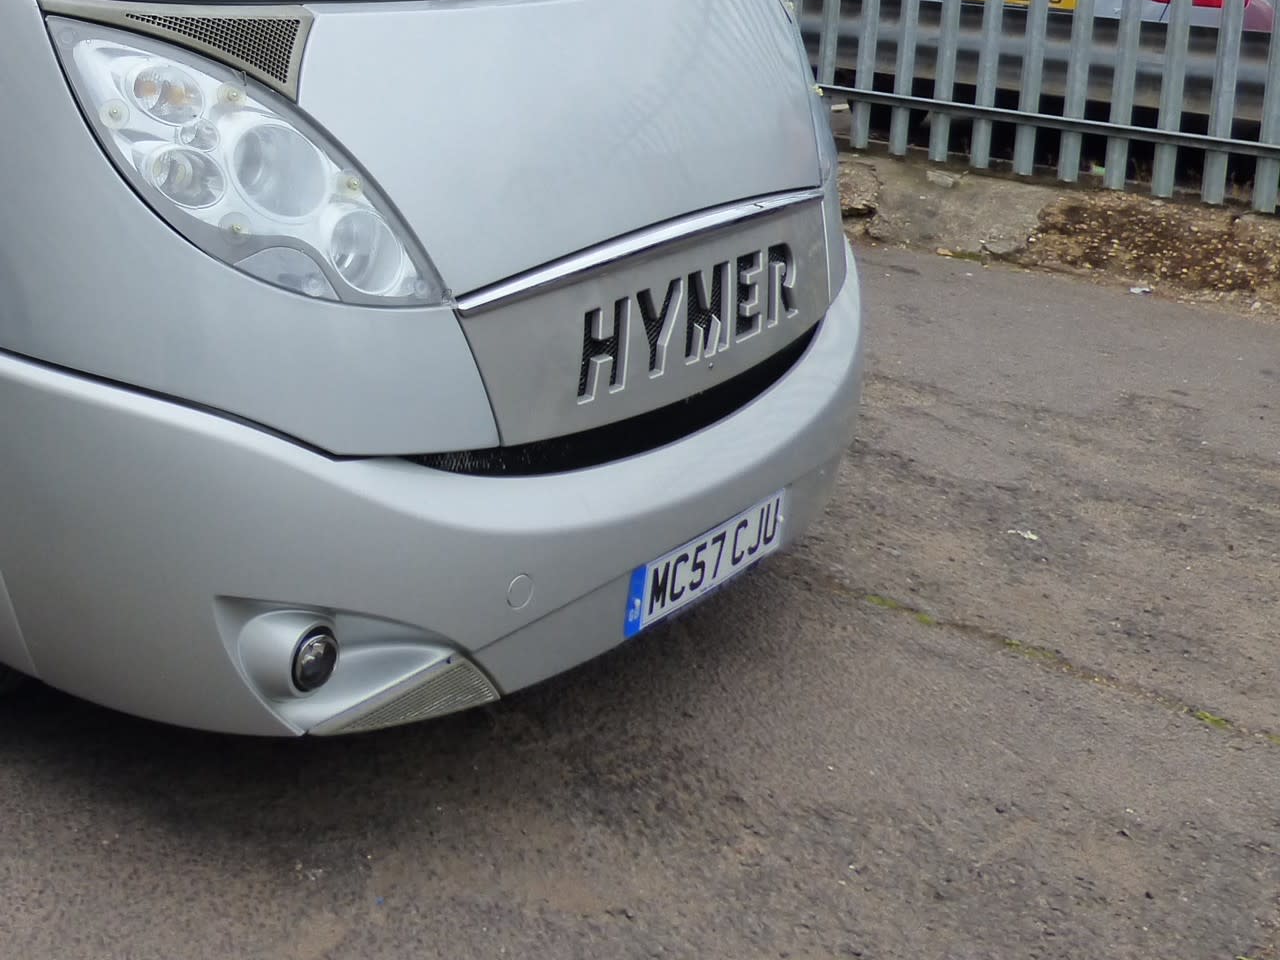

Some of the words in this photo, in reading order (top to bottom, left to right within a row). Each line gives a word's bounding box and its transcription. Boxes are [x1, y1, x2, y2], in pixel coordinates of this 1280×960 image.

[577, 243, 800, 405] HYMER
[648, 531, 727, 616] MC57
[731, 497, 780, 566] CJU
